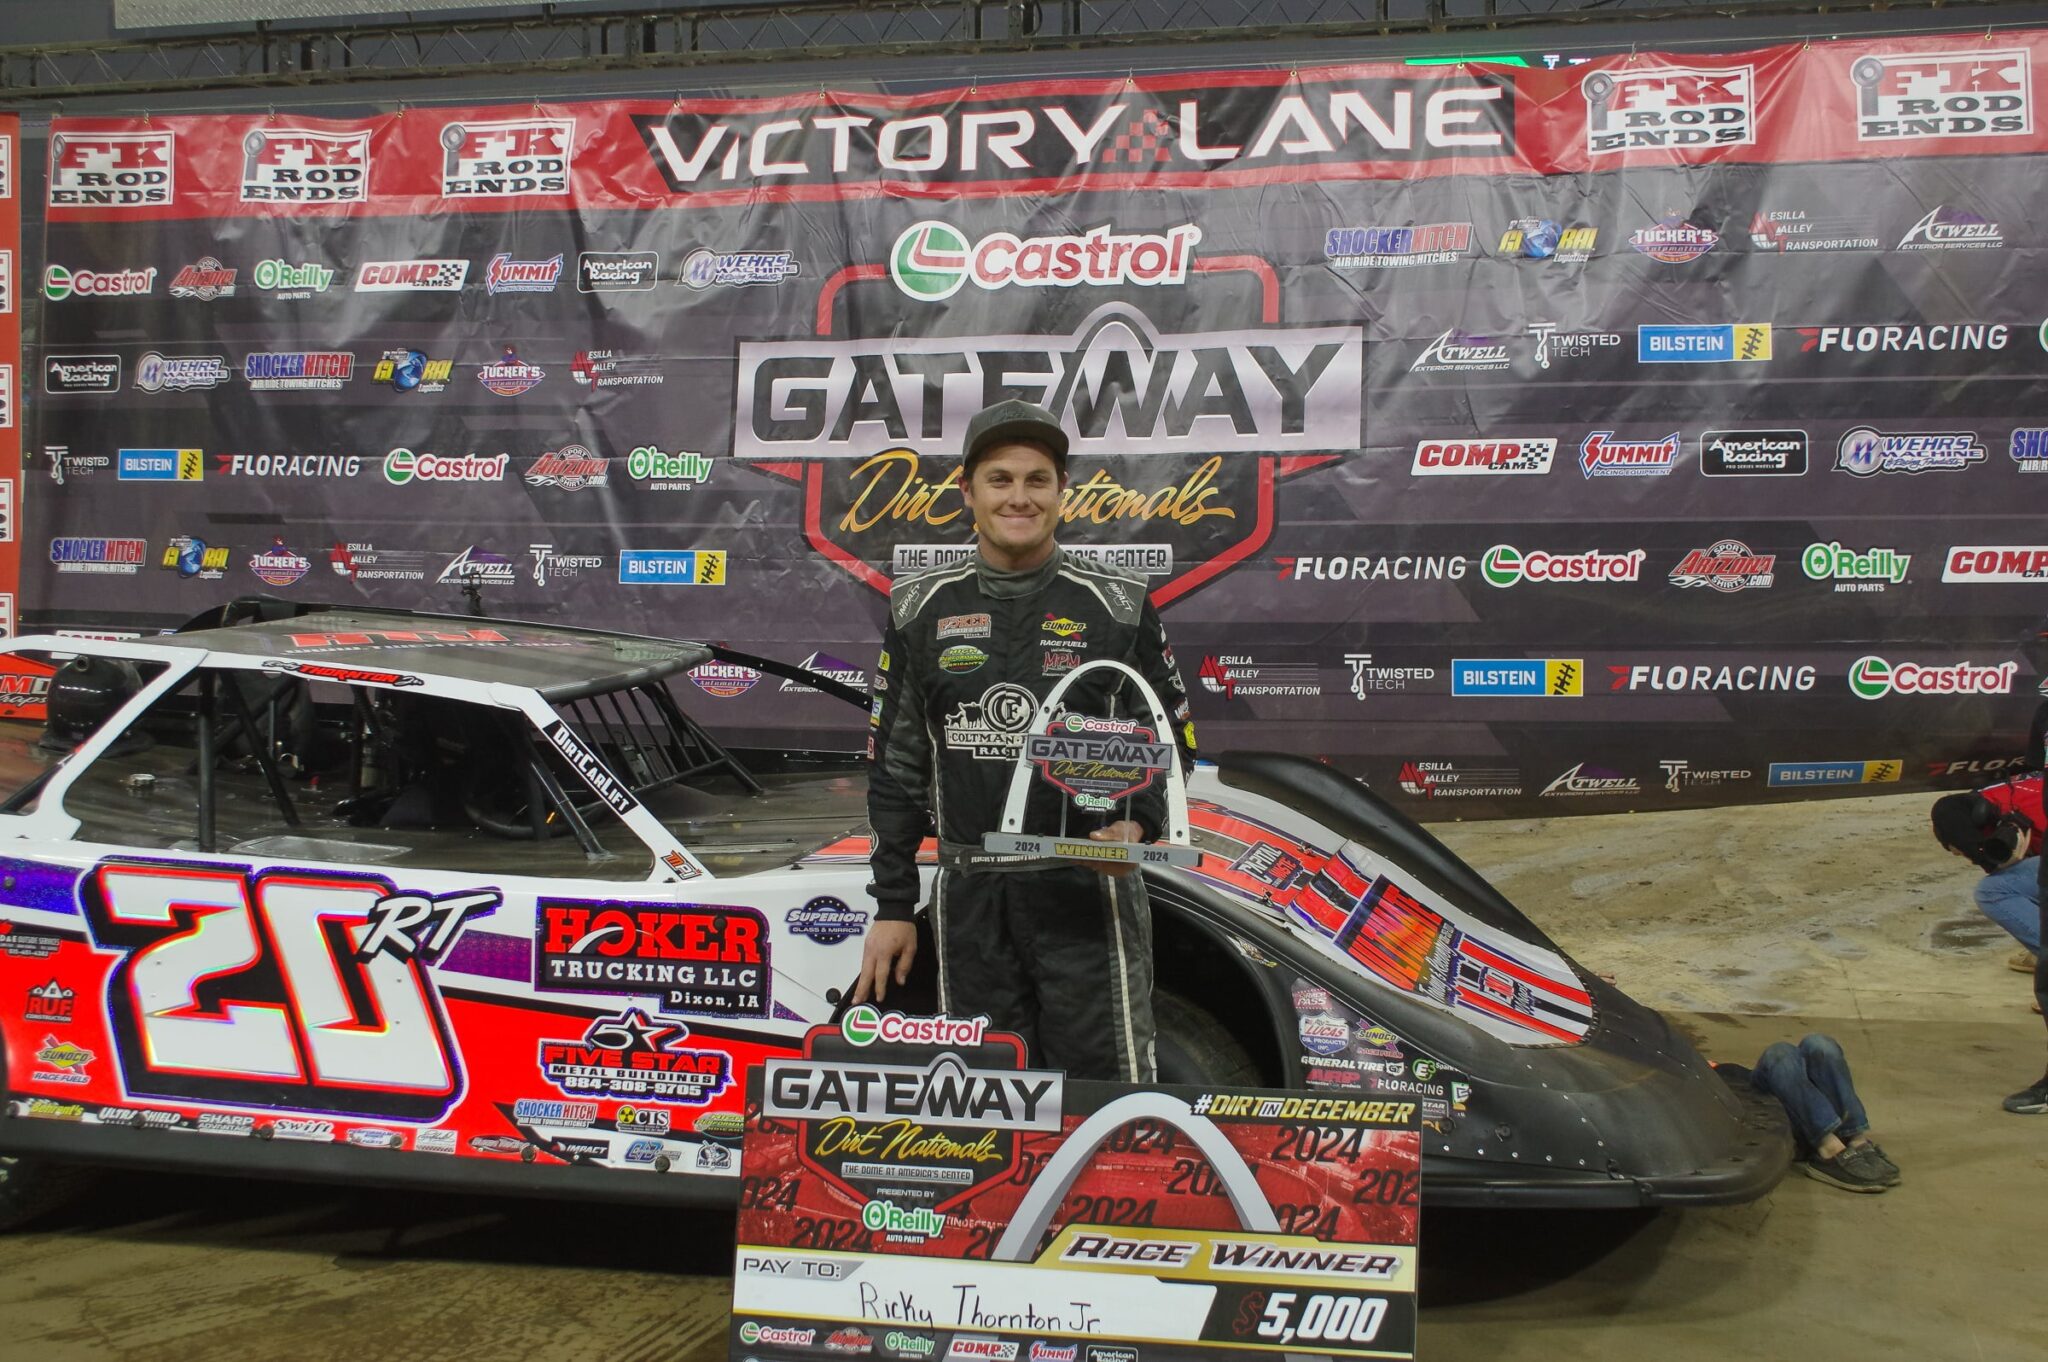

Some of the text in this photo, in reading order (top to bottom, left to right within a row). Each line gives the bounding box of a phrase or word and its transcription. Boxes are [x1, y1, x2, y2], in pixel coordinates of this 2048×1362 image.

[1898, 96, 2022, 115] ROD
[1625, 108, 1746, 127] ROD
[649, 87, 1502, 181] VICTORY LANE
[1862, 116, 2023, 137] ENDS
[1591, 128, 1747, 151] ENDS
[62, 131, 169, 168] FK
[273, 167, 360, 184] ROD
[473, 160, 564, 175] ROD
[77, 169, 167, 187] ROD
[445, 177, 565, 194] ENDS
[51, 188, 167, 204] ENDS
[243, 185, 360, 201] ENDS
[1898, 205, 2000, 249] ATWELL
[1328, 224, 1469, 255] SHOCKERHITCH
[1635, 229, 1714, 243] TUCKER'S
[716, 254, 787, 267] WEHRS
[975, 229, 1189, 285] Castrol
[1335, 252, 1457, 266] AIR RIDE TOWING HITCHES
[361, 264, 438, 284] COMP
[583, 260, 652, 272] American
[716, 265, 798, 274] MACHINE
[75, 269, 154, 294] Castrol
[256, 260, 331, 290] O'Reilly
[412, 278, 453, 287] CAMS
[590, 269, 641, 284] Racing
[292, 292, 311, 300] PARTS
[1551, 335, 1621, 347] TWISTED
[1650, 335, 1724, 351] BILSTEIN
[1819, 325, 2007, 352] FLORACING
[1552, 347, 1590, 357] TECH
[51, 363, 117, 374] American
[483, 365, 540, 379] TUCKER'S
[62, 373, 110, 386] Racing
[1709, 439, 1800, 450] American
[1885, 437, 1972, 450] WEHRS
[64, 457, 109, 467] TWISTED
[1419, 444, 1520, 466] COMP
[1723, 450, 1787, 468] Racing
[66, 467, 94, 475] TECH
[125, 458, 172, 472] BILSTEIN
[231, 455, 360, 477] FLORACING
[417, 455, 504, 480] Castrol
[629, 448, 711, 482] O'Reilly
[1488, 462, 1538, 470] CAMS
[840, 449, 964, 532] Dirt
[52, 540, 144, 561] SHOCKERHITCH
[899, 550, 927, 567] THE
[254, 555, 307, 567] TUCKER'S
[547, 557, 602, 568] TWISTED
[628, 560, 686, 574] BILSTEIN
[1105, 549, 1167, 569] CENTER
[1525, 552, 1637, 579] Castrol
[1803, 543, 1909, 582] O'Reilly
[548, 569, 578, 577] TECH
[1295, 556, 1466, 580] FLORACING
[1835, 584, 1885, 592] AUTO PARTS
[1043, 620, 1086, 631] SUNOCO
[299, 664, 400, 681] THORNTON
[1367, 668, 1434, 680] TWISTED
[1463, 671, 1536, 686] BILSTEIN
[1629, 666, 1816, 691] FLORACING
[1894, 664, 2009, 690] Castrol
[1367, 680, 1405, 690] TECH
[1084, 721, 1134, 733] Castrol
[952, 733, 1016, 745] COLTMAN
[1031, 739, 1165, 764] GATEWAY
[1681, 769, 1751, 781] TWISTED
[1780, 768, 1854, 781] BILSTEIN
[1015, 841, 1169, 862] 2024 WINNER 2024
[787, 909, 868, 923] SUPERIOR
[360, 892, 498, 957] RT
[792, 925, 819, 933] GLASS
[545, 908, 761, 963] HOKER
[551, 960, 757, 987] TRUCKING LLC
[28, 998, 72, 1015] RUF
[670, 990, 759, 1008] Dixon, IA
[882, 1016, 980, 1043] Castrol
[1306, 1026, 1345, 1037] LUCAS
[1359, 1030, 1397, 1041] SUNOCO
[43, 1051, 89, 1062] SUNOCO
[543, 1046, 721, 1075] FIVE STAR
[1301, 1056, 1385, 1071] GENERAL TIRE
[34, 1073, 88, 1083] RACE FUELS
[552, 1065, 712, 1084] METAL BUILDINGS
[772, 1067, 1054, 1122] GATEWAY
[1377, 1079, 1444, 1095] FLORACING
[141, 1110, 181, 1123] SHIELD
[199, 1114, 254, 1126] SHARP
[635, 1110, 668, 1126] CIS
[275, 1120, 332, 1134] Swift
[815, 1118, 1003, 1162] Dirt Nationals
[1271, 1127, 1364, 1163] 2024
[566, 1145, 607, 1155] IMPACT
[844, 1164, 971, 1180] THE DOME AT AMERICA'S CENTER
[877, 1187, 935, 1198] PRESENTED BY
[863, 1201, 946, 1234] O'Reilly
[886, 1233, 924, 1243] AUTO PARTS
[1066, 1236, 1398, 1275] RACE WINNER
[743, 1258, 841, 1277] PAY TO:
[860, 1282, 1060, 1336] Ricky Thornton
[1232, 1291, 1388, 1343] $5,000
[760, 1328, 814, 1344] Castrol
[953, 1341, 1002, 1354] COMP
